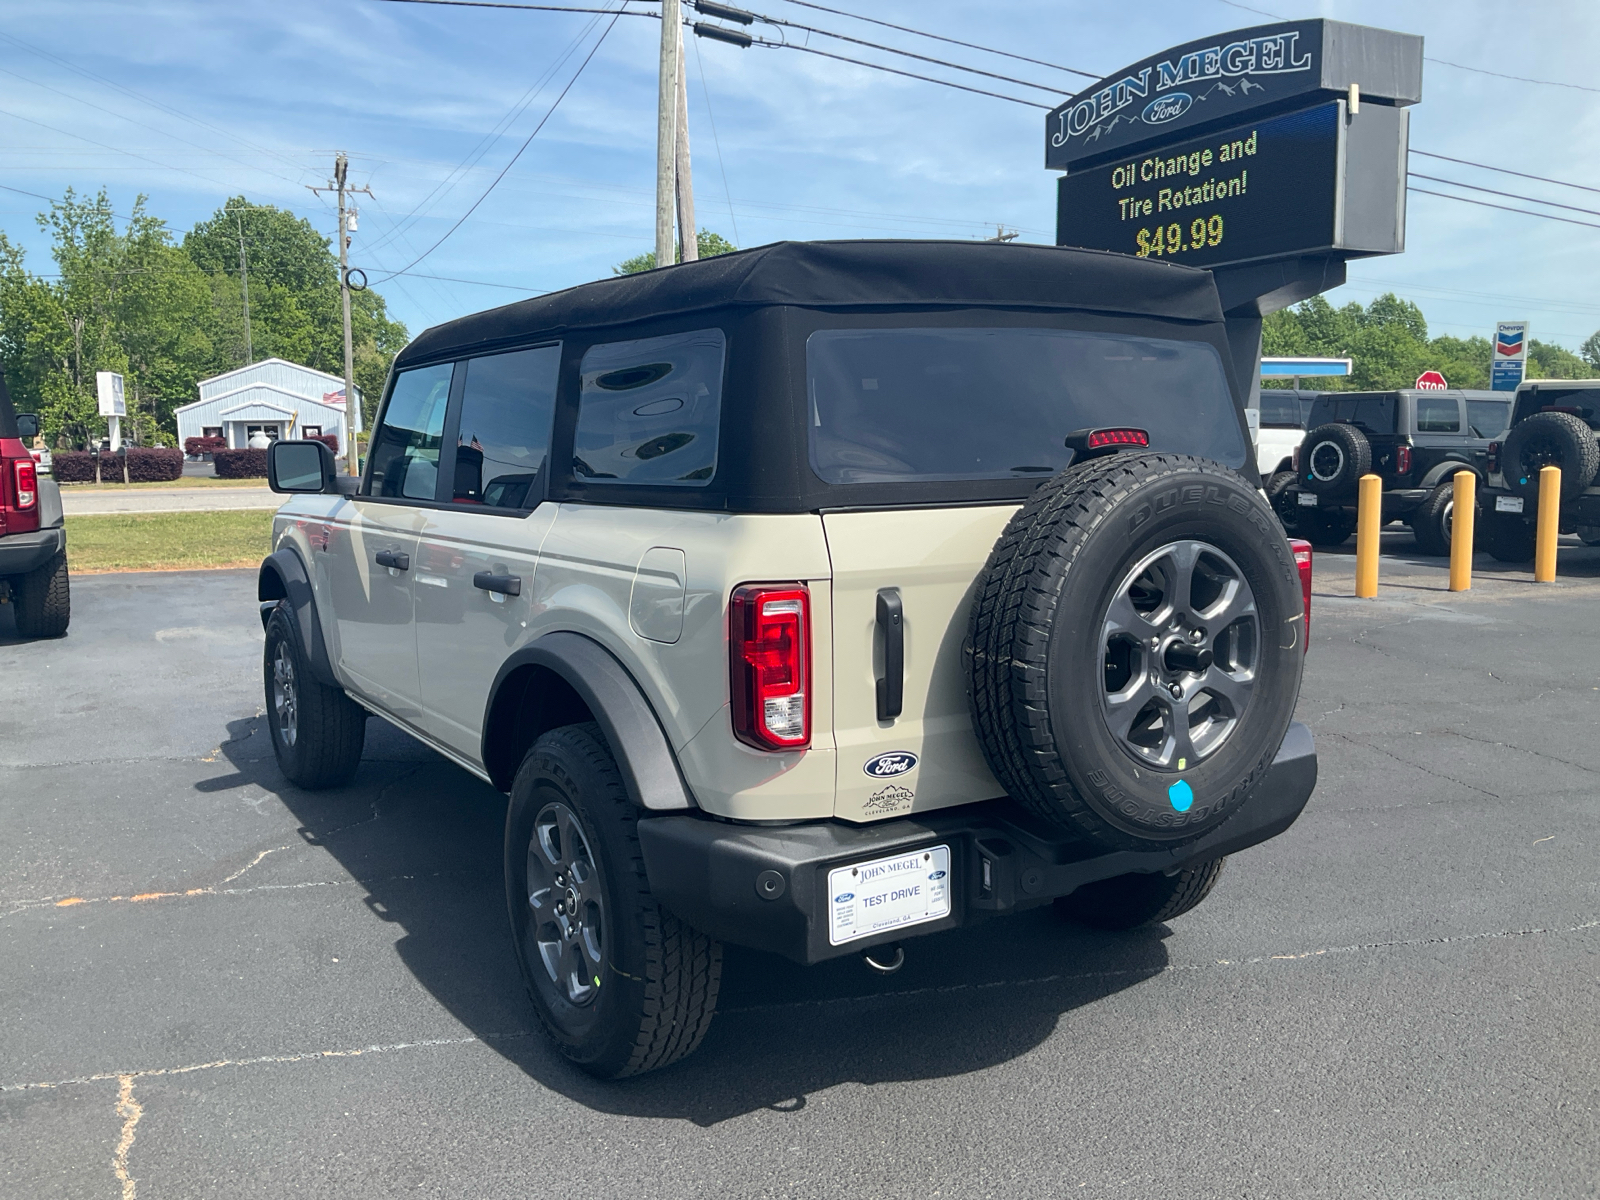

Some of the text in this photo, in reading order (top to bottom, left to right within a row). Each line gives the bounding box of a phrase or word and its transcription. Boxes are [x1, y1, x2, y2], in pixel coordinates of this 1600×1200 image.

[1052, 31, 1311, 147] JOHN MEGEL
[1150, 97, 1182, 122] Ford
[1112, 131, 1258, 190] Oil Change and
[1118, 170, 1248, 221] Tire Rotation!
[1136, 214, 1224, 258] $49.99
[1419, 381, 1444, 390] STOP
[1127, 485, 1270, 535] DUELER
[875, 756, 909, 775] Ford
[868, 791, 909, 804] JOHN MEGEL
[860, 858, 922, 884] JOHN MEGEL
[863, 885, 921, 907] TEST DRIVE
[872, 917, 901, 929] Cleveland,
